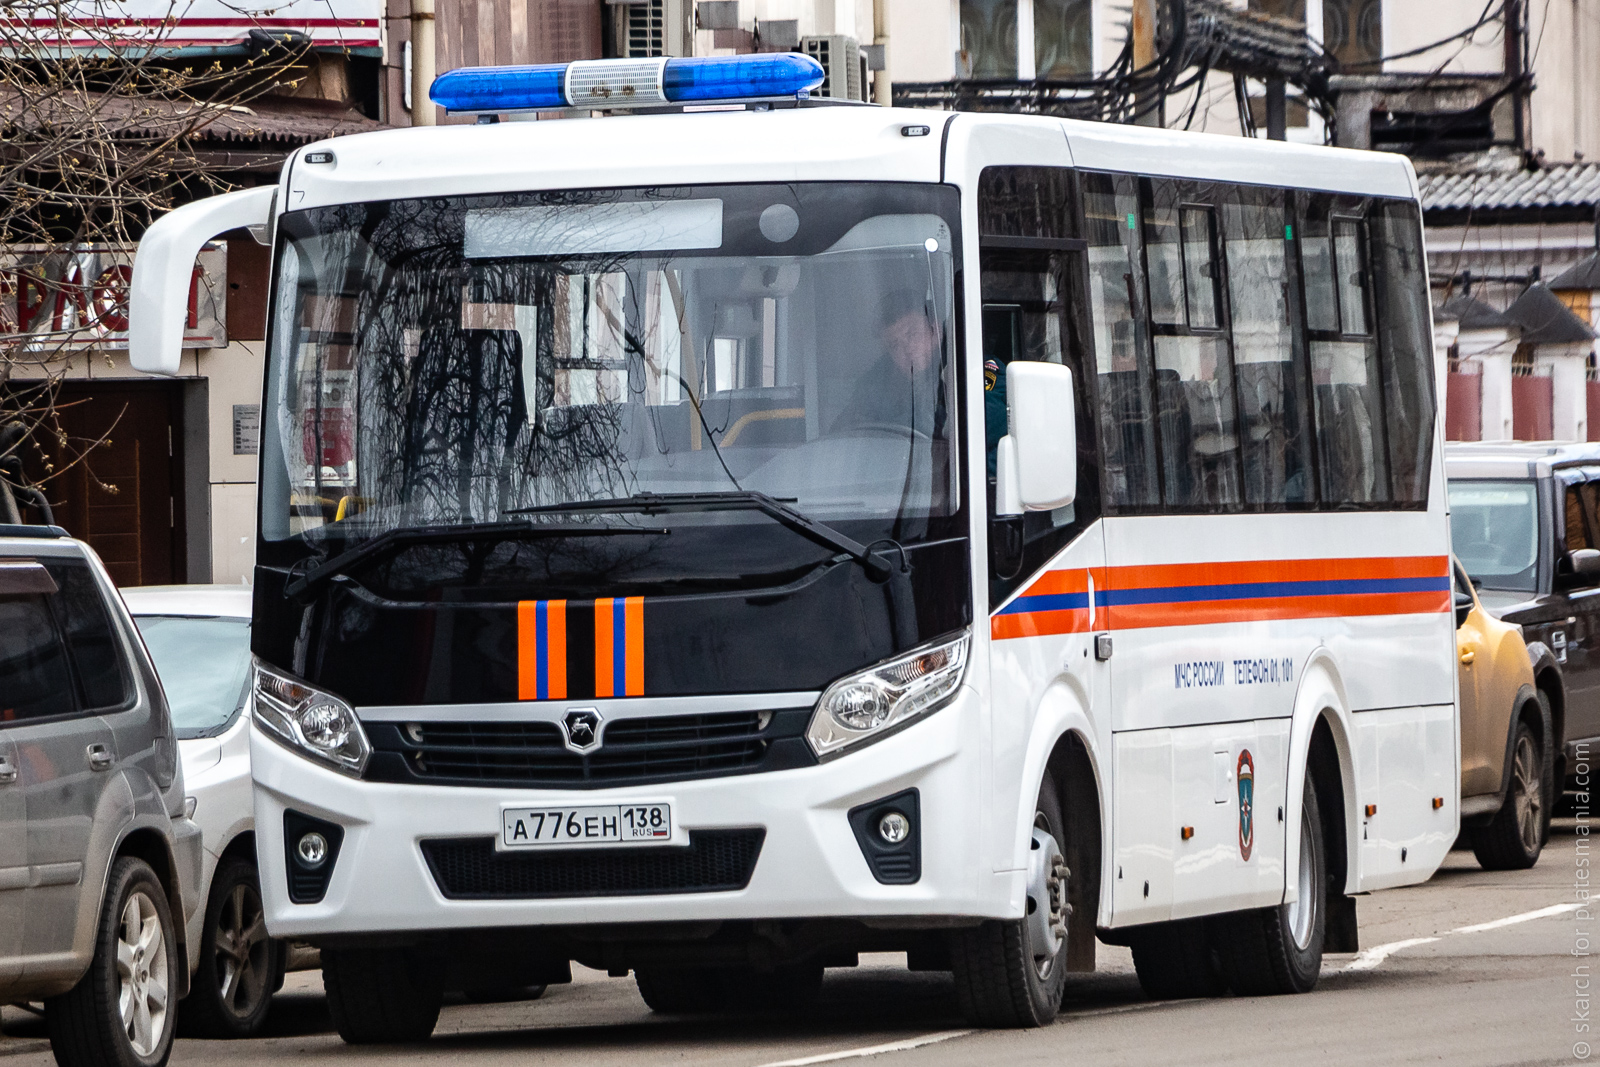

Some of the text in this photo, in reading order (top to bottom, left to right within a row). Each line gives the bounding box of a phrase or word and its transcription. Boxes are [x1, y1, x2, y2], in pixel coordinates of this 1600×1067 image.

[1174, 662, 1191, 688] МЧС
[1193, 661, 1225, 687] РОССИИ
[1233, 659, 1268, 685] ТЕЛЕФОН
[1282, 658, 1293, 682] 101
[513, 807, 662, 840] А776ЕН 138
[632, 828, 652, 837] RUS
